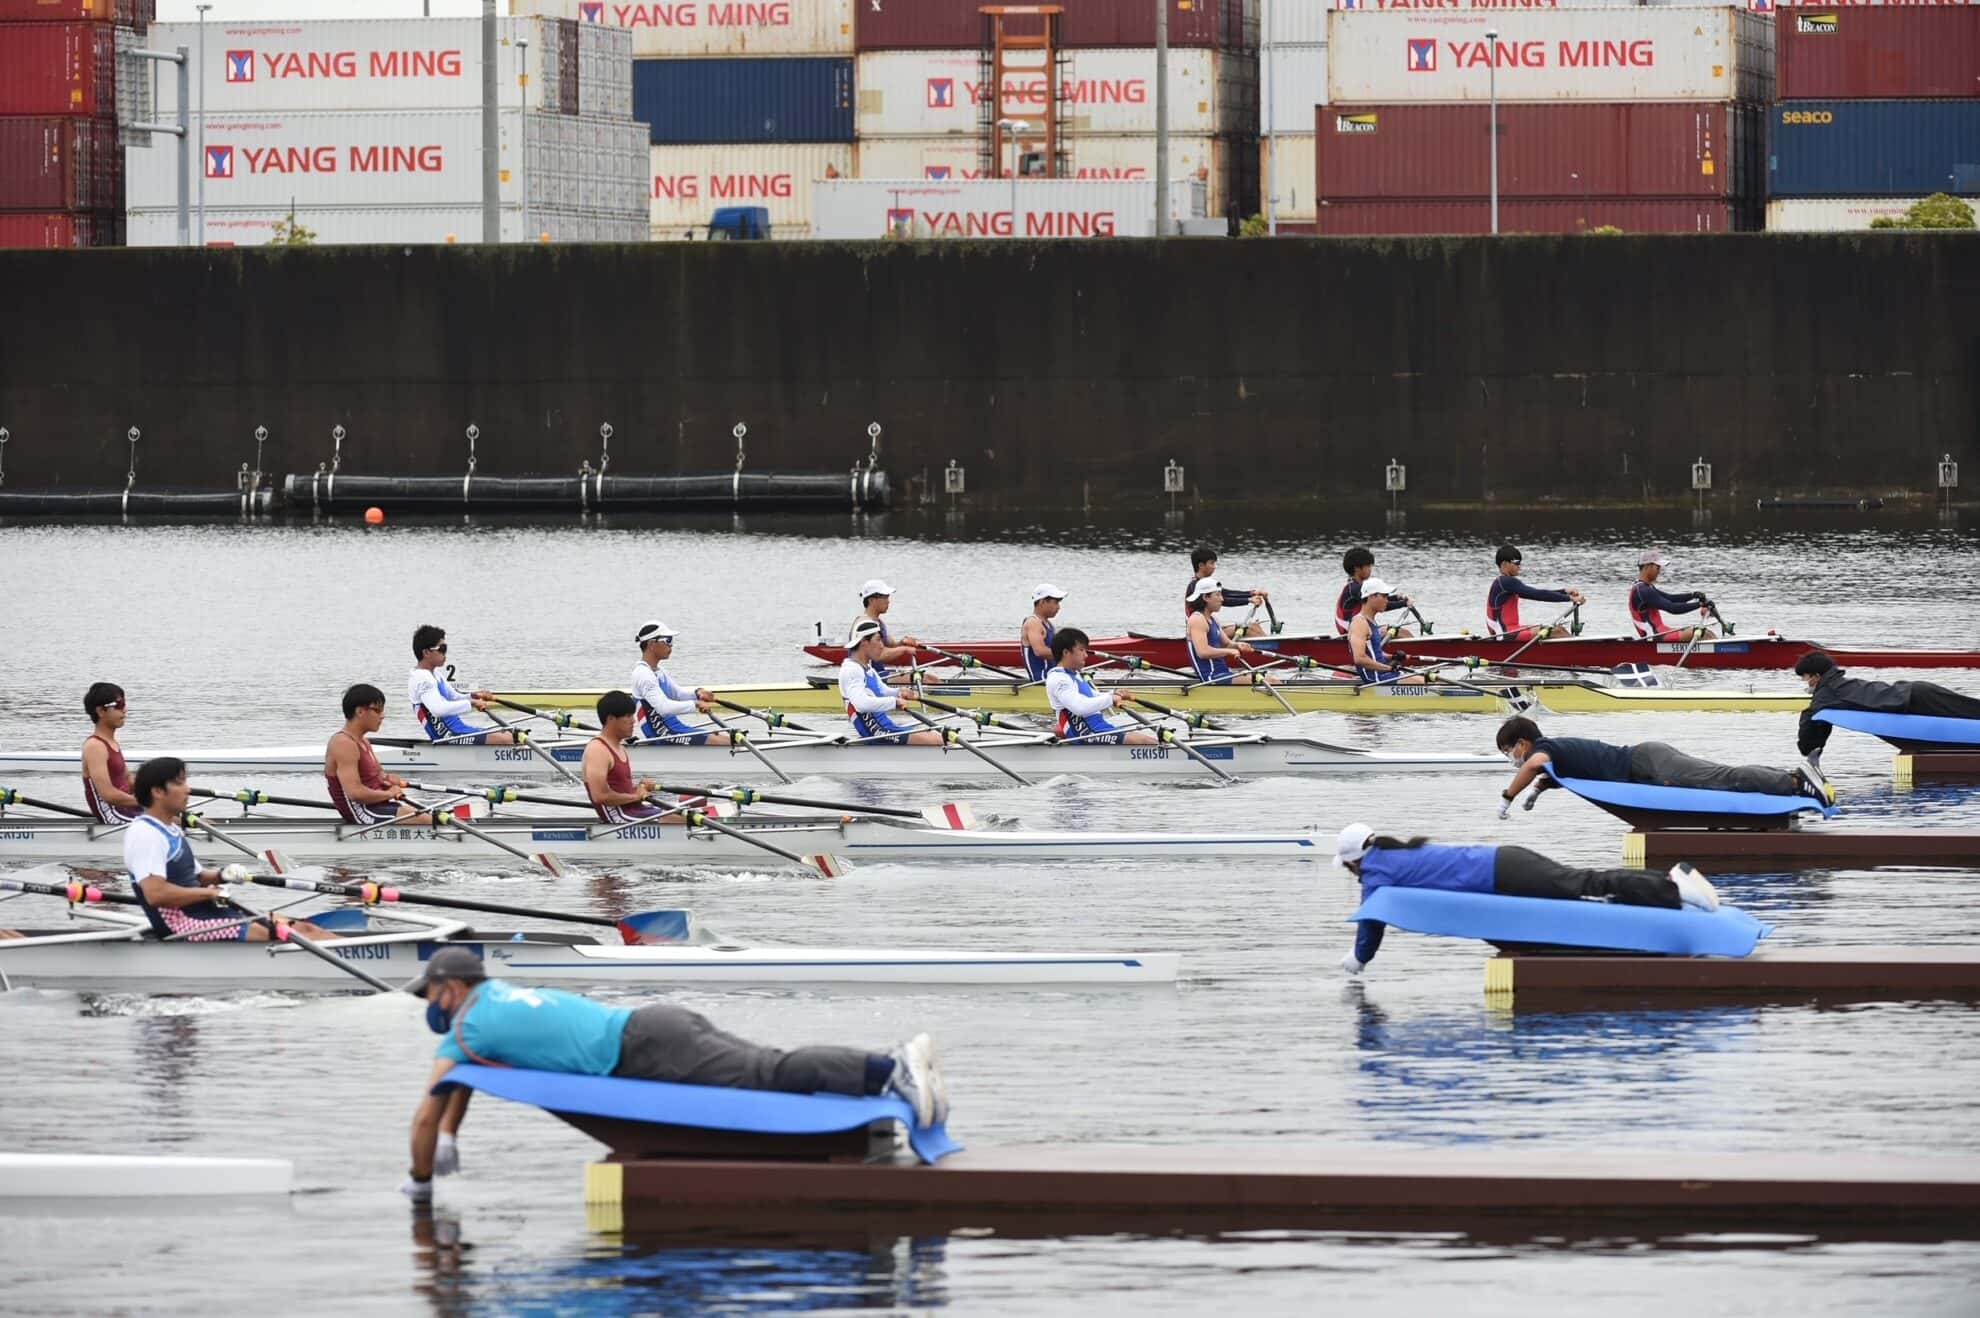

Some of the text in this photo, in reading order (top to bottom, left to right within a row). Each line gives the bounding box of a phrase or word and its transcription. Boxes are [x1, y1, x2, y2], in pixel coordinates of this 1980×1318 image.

[614, 1, 791, 28] YANG MING
[263, 49, 463, 80] YANG MING
[1448, 40, 1656, 70] YANG MING
[1061, 79, 1146, 105] MING
[1782, 111, 1833, 124] seaco
[243, 145, 444, 174] YANG MING
[650, 173, 793, 199] NG MING
[922, 211, 1116, 237] YANG MING
[814, 621, 822, 637] 1
[446, 664, 456, 682] 2
[1391, 686, 1424, 696] SEKISUI
[494, 750, 532, 761] SEKISUI
[1130, 748, 1169, 760] SEKISUI
[615, 826, 661, 839] SEKISUI
